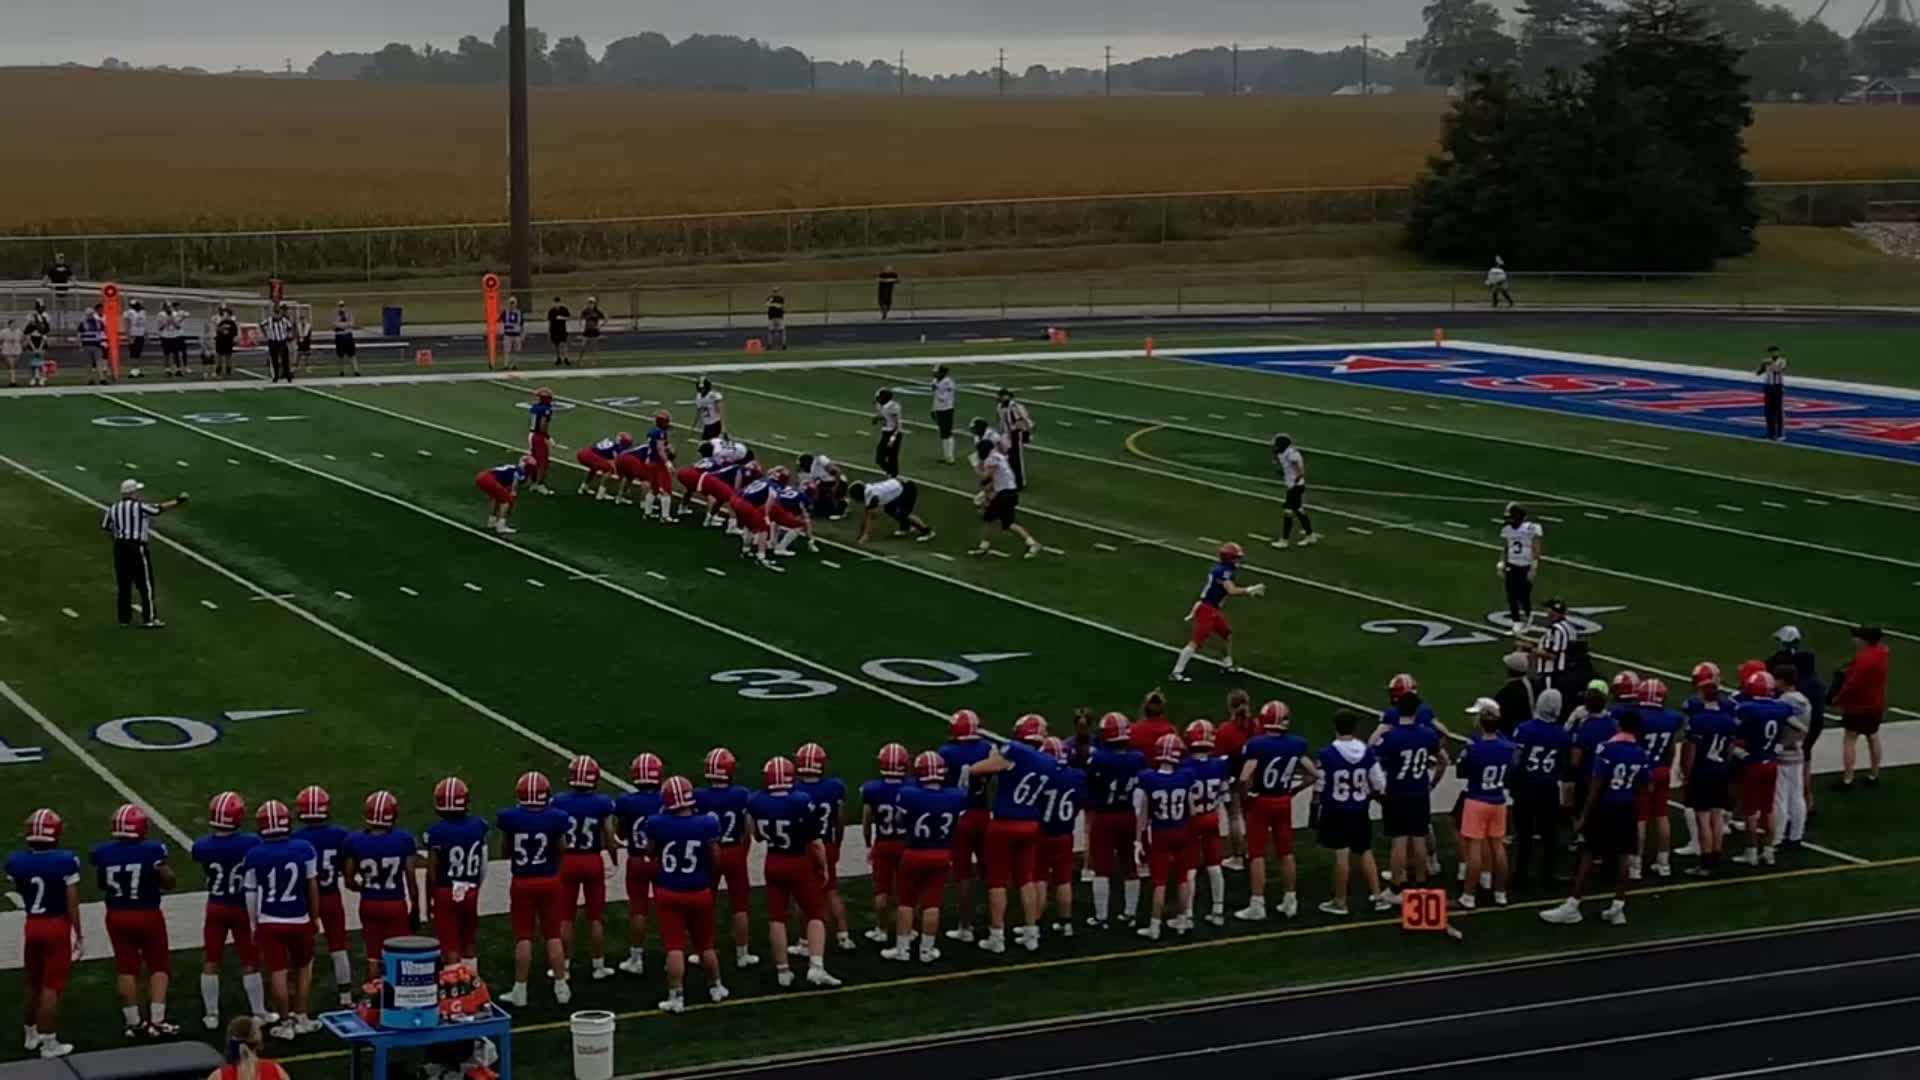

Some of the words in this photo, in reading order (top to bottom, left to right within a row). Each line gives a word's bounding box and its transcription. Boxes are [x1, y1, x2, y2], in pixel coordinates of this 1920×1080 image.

[1763, 719, 1779, 751] 9
[1396, 747, 1429, 780] 70
[1331, 767, 1370, 802] 69
[1151, 788, 1186, 822] 30
[914, 812, 954, 840] 63
[447, 840, 481, 878] 86
[513, 832, 549, 867] 52
[661, 840, 702, 874] 65
[105, 863, 142, 900] 57
[265, 861, 299, 902] 12
[359, 856, 401, 889] 27
[29, 876, 48, 914] 2
[1406, 893, 1441, 926] 30
